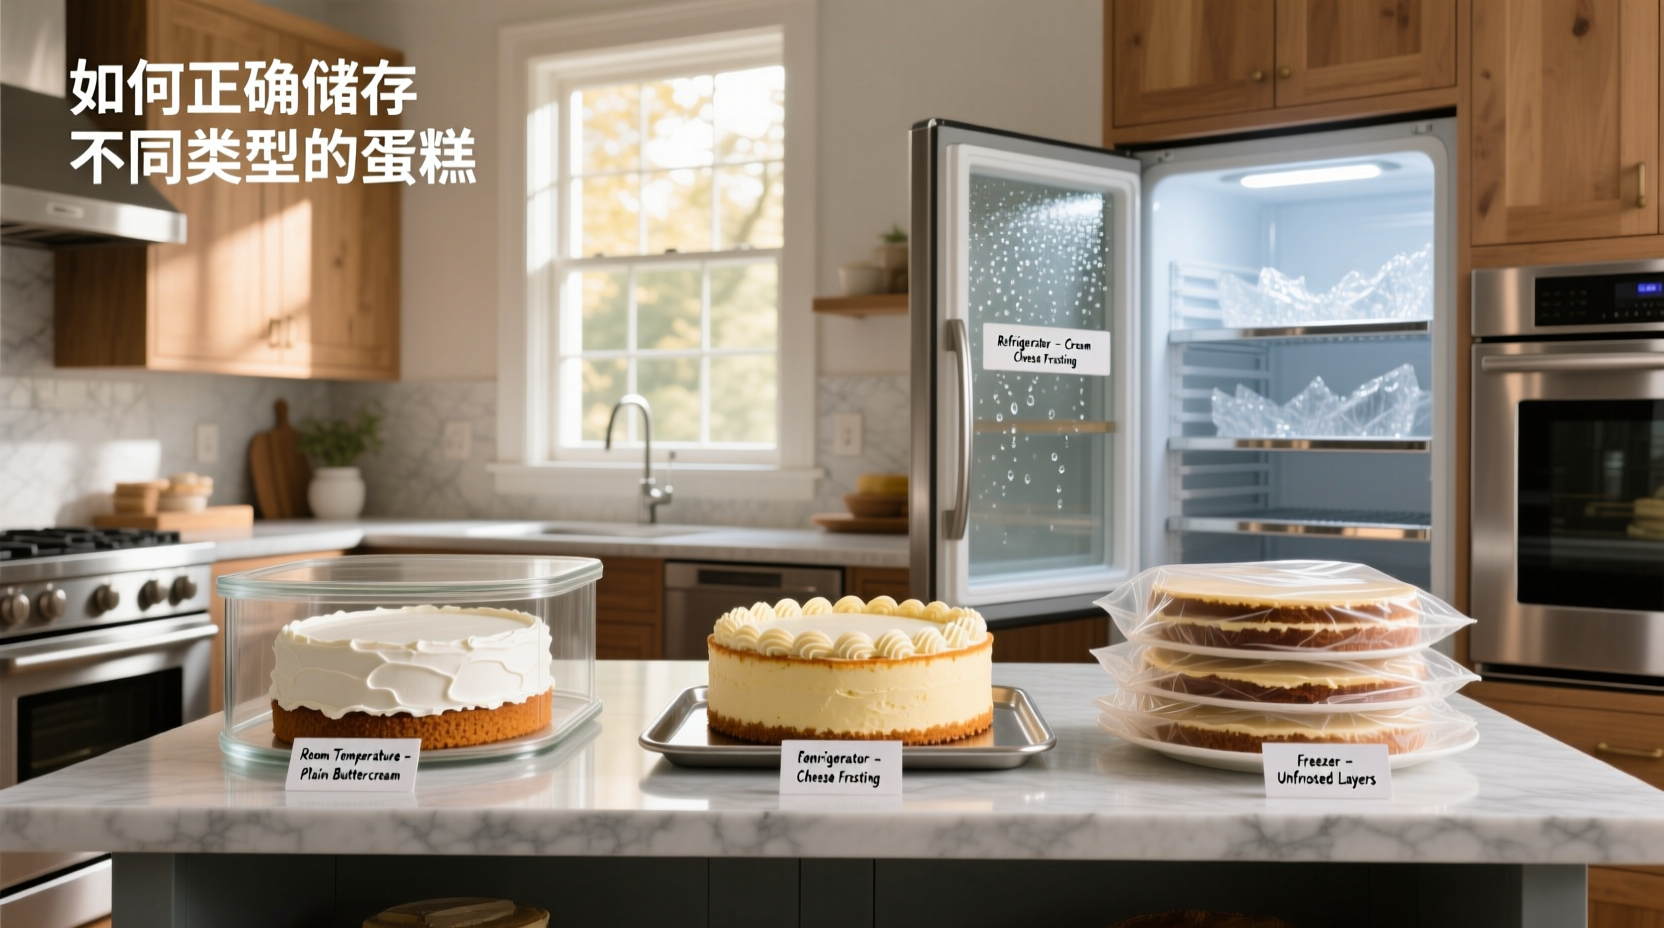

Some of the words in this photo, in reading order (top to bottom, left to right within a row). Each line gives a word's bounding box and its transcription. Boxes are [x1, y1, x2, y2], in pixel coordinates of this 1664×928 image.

[299, 747, 330, 761] Room
[333, 747, 401, 769] Temperature
[1297, 753, 1341, 768] Freezer
[299, 766, 329, 781] Plain
[332, 766, 401, 781] Buttercream
[1338, 771, 1377, 790] Layers
